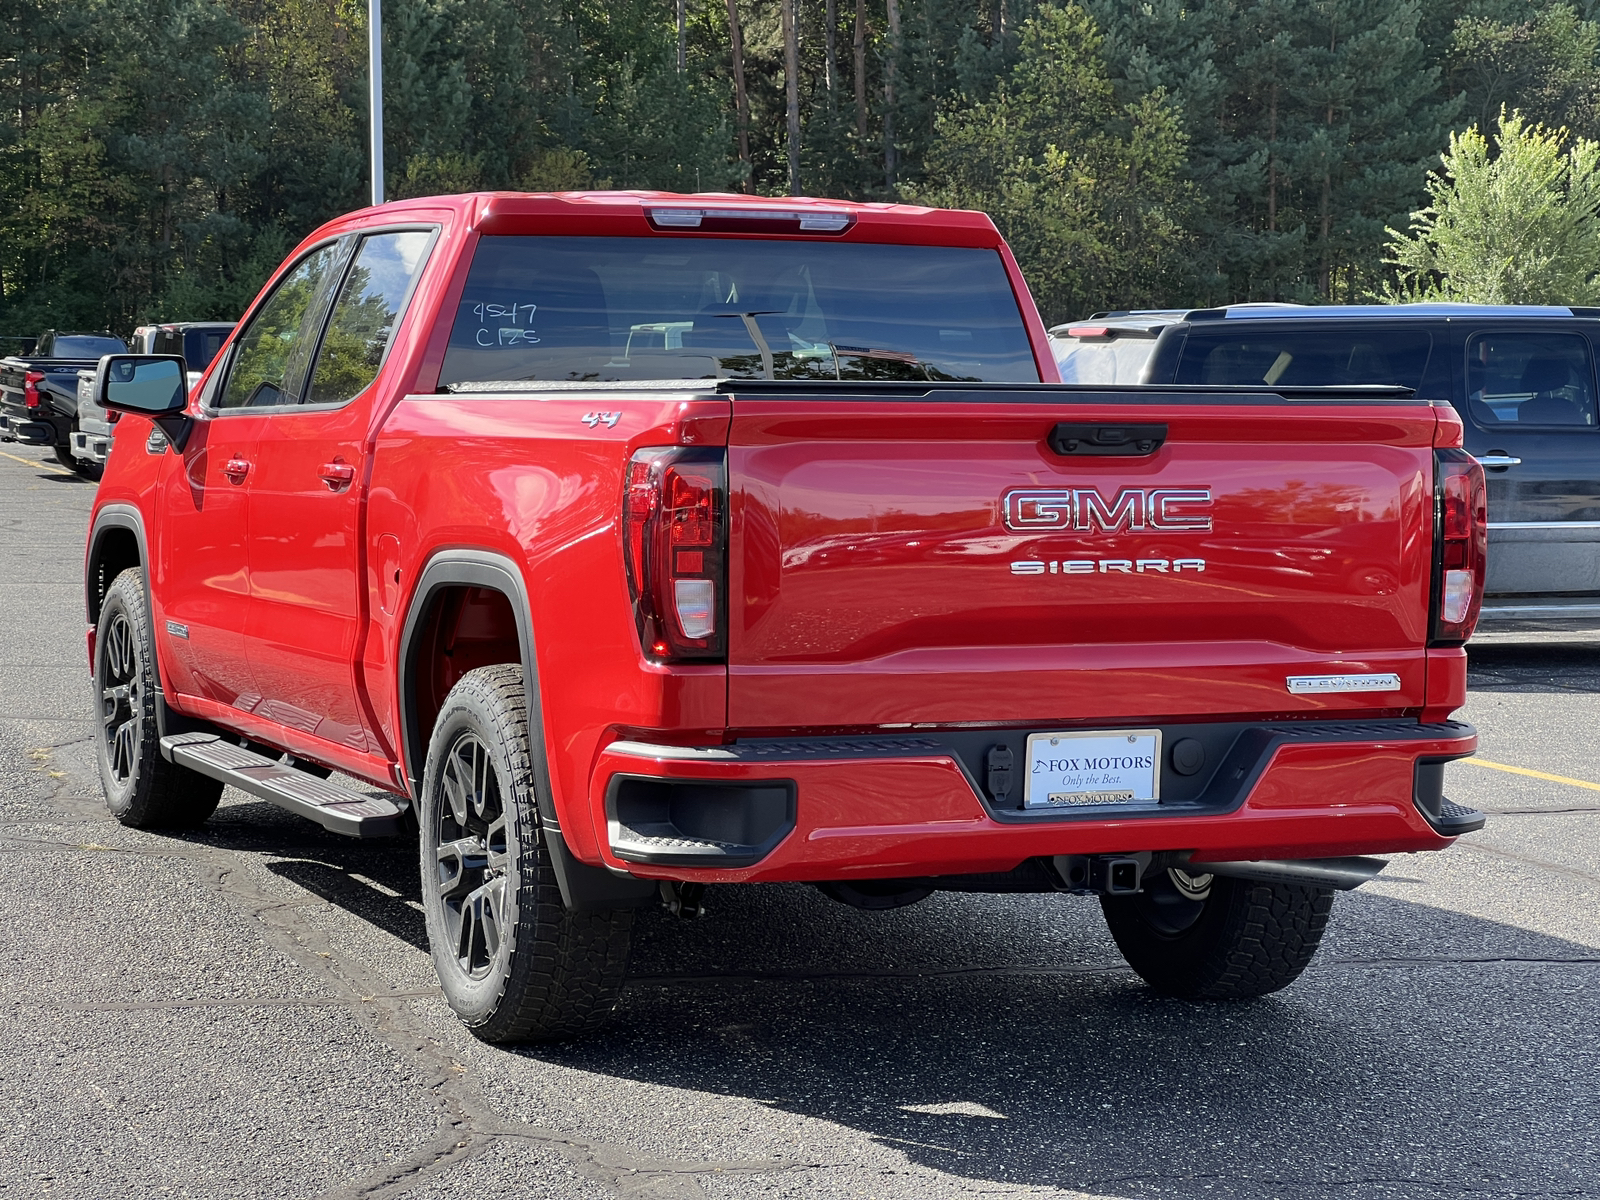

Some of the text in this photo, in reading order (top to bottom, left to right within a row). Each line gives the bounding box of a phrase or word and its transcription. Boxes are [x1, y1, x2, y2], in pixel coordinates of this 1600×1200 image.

[473, 302, 537, 324] 4547
[1003, 488, 1213, 530] GMC
[1010, 558, 1206, 575] SIERRA
[1049, 756, 1152, 772] FOX MOTORS
[1062, 773, 1122, 788] Only the Best.
[1064, 793, 1128, 805] FOX MOTORS
